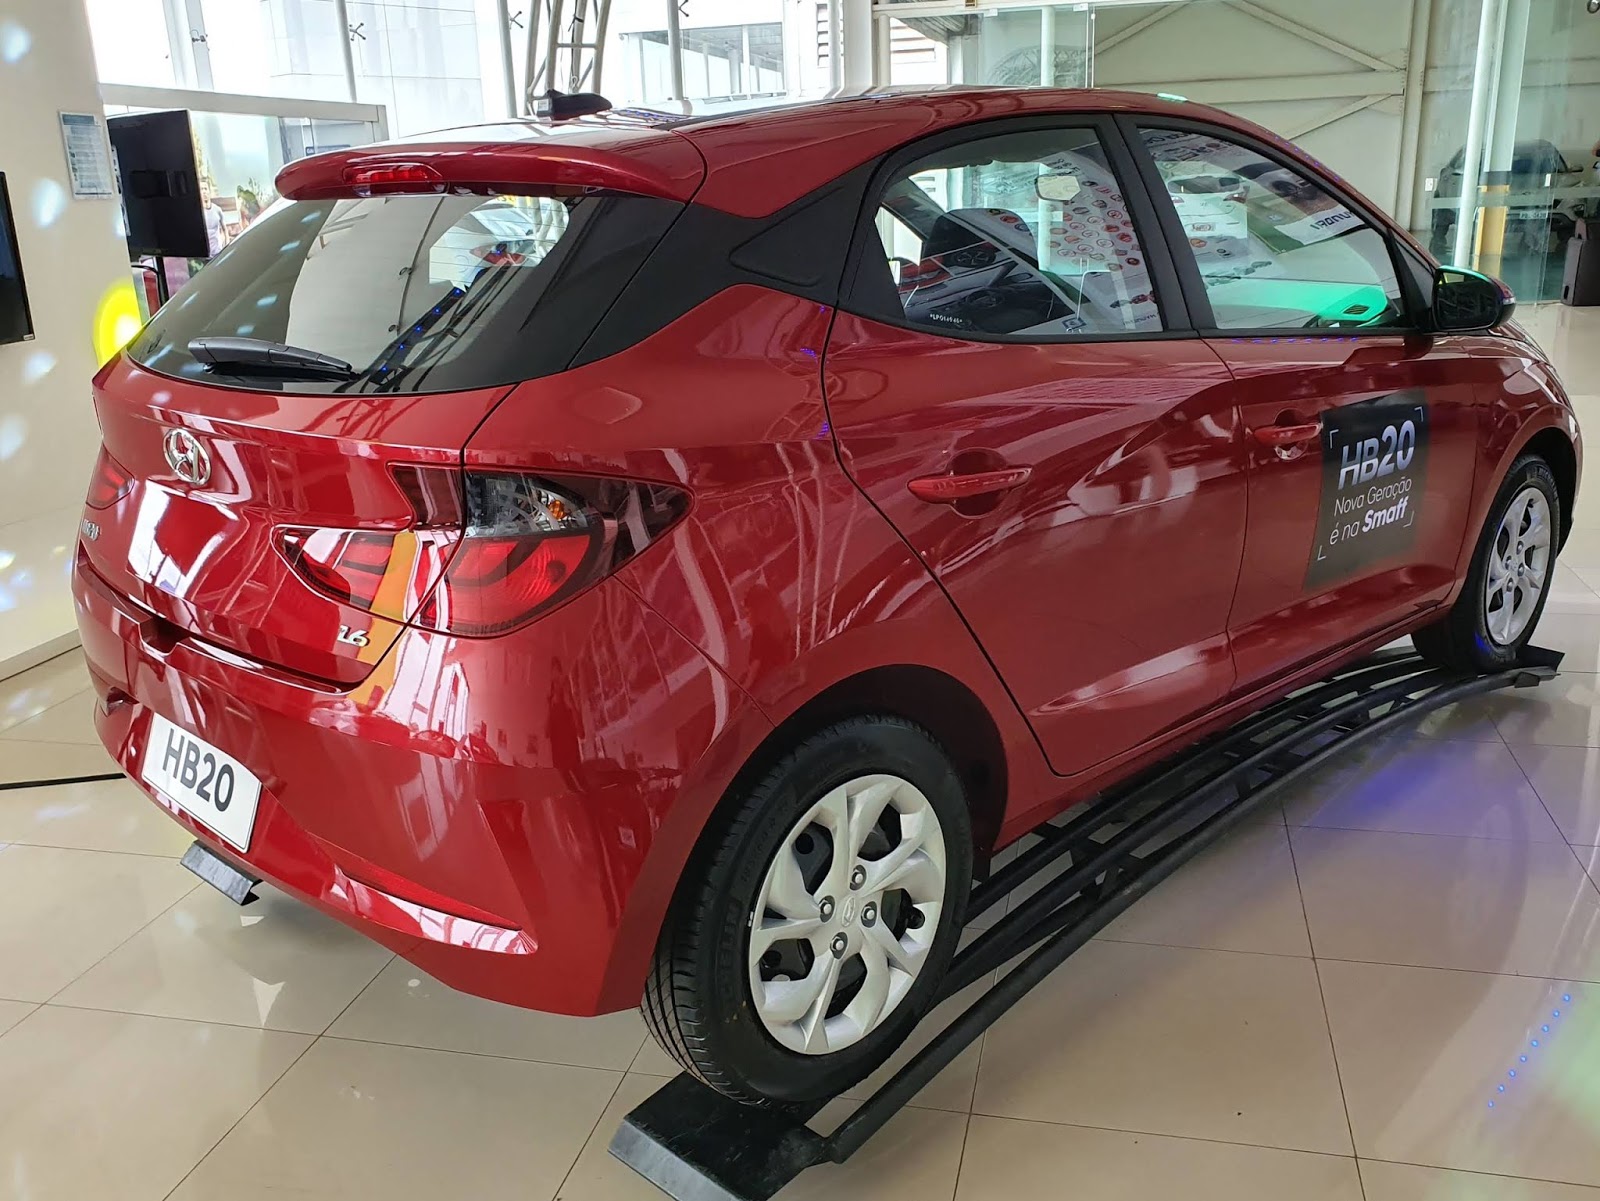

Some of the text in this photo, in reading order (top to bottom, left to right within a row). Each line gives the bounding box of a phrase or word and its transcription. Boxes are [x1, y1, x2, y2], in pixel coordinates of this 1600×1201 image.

[1338, 420, 1416, 490] HB20
[1329, 496, 1410, 545] é na Smaff
[1334, 476, 1412, 517] Nova Geração
[162, 728, 235, 812] HB20
